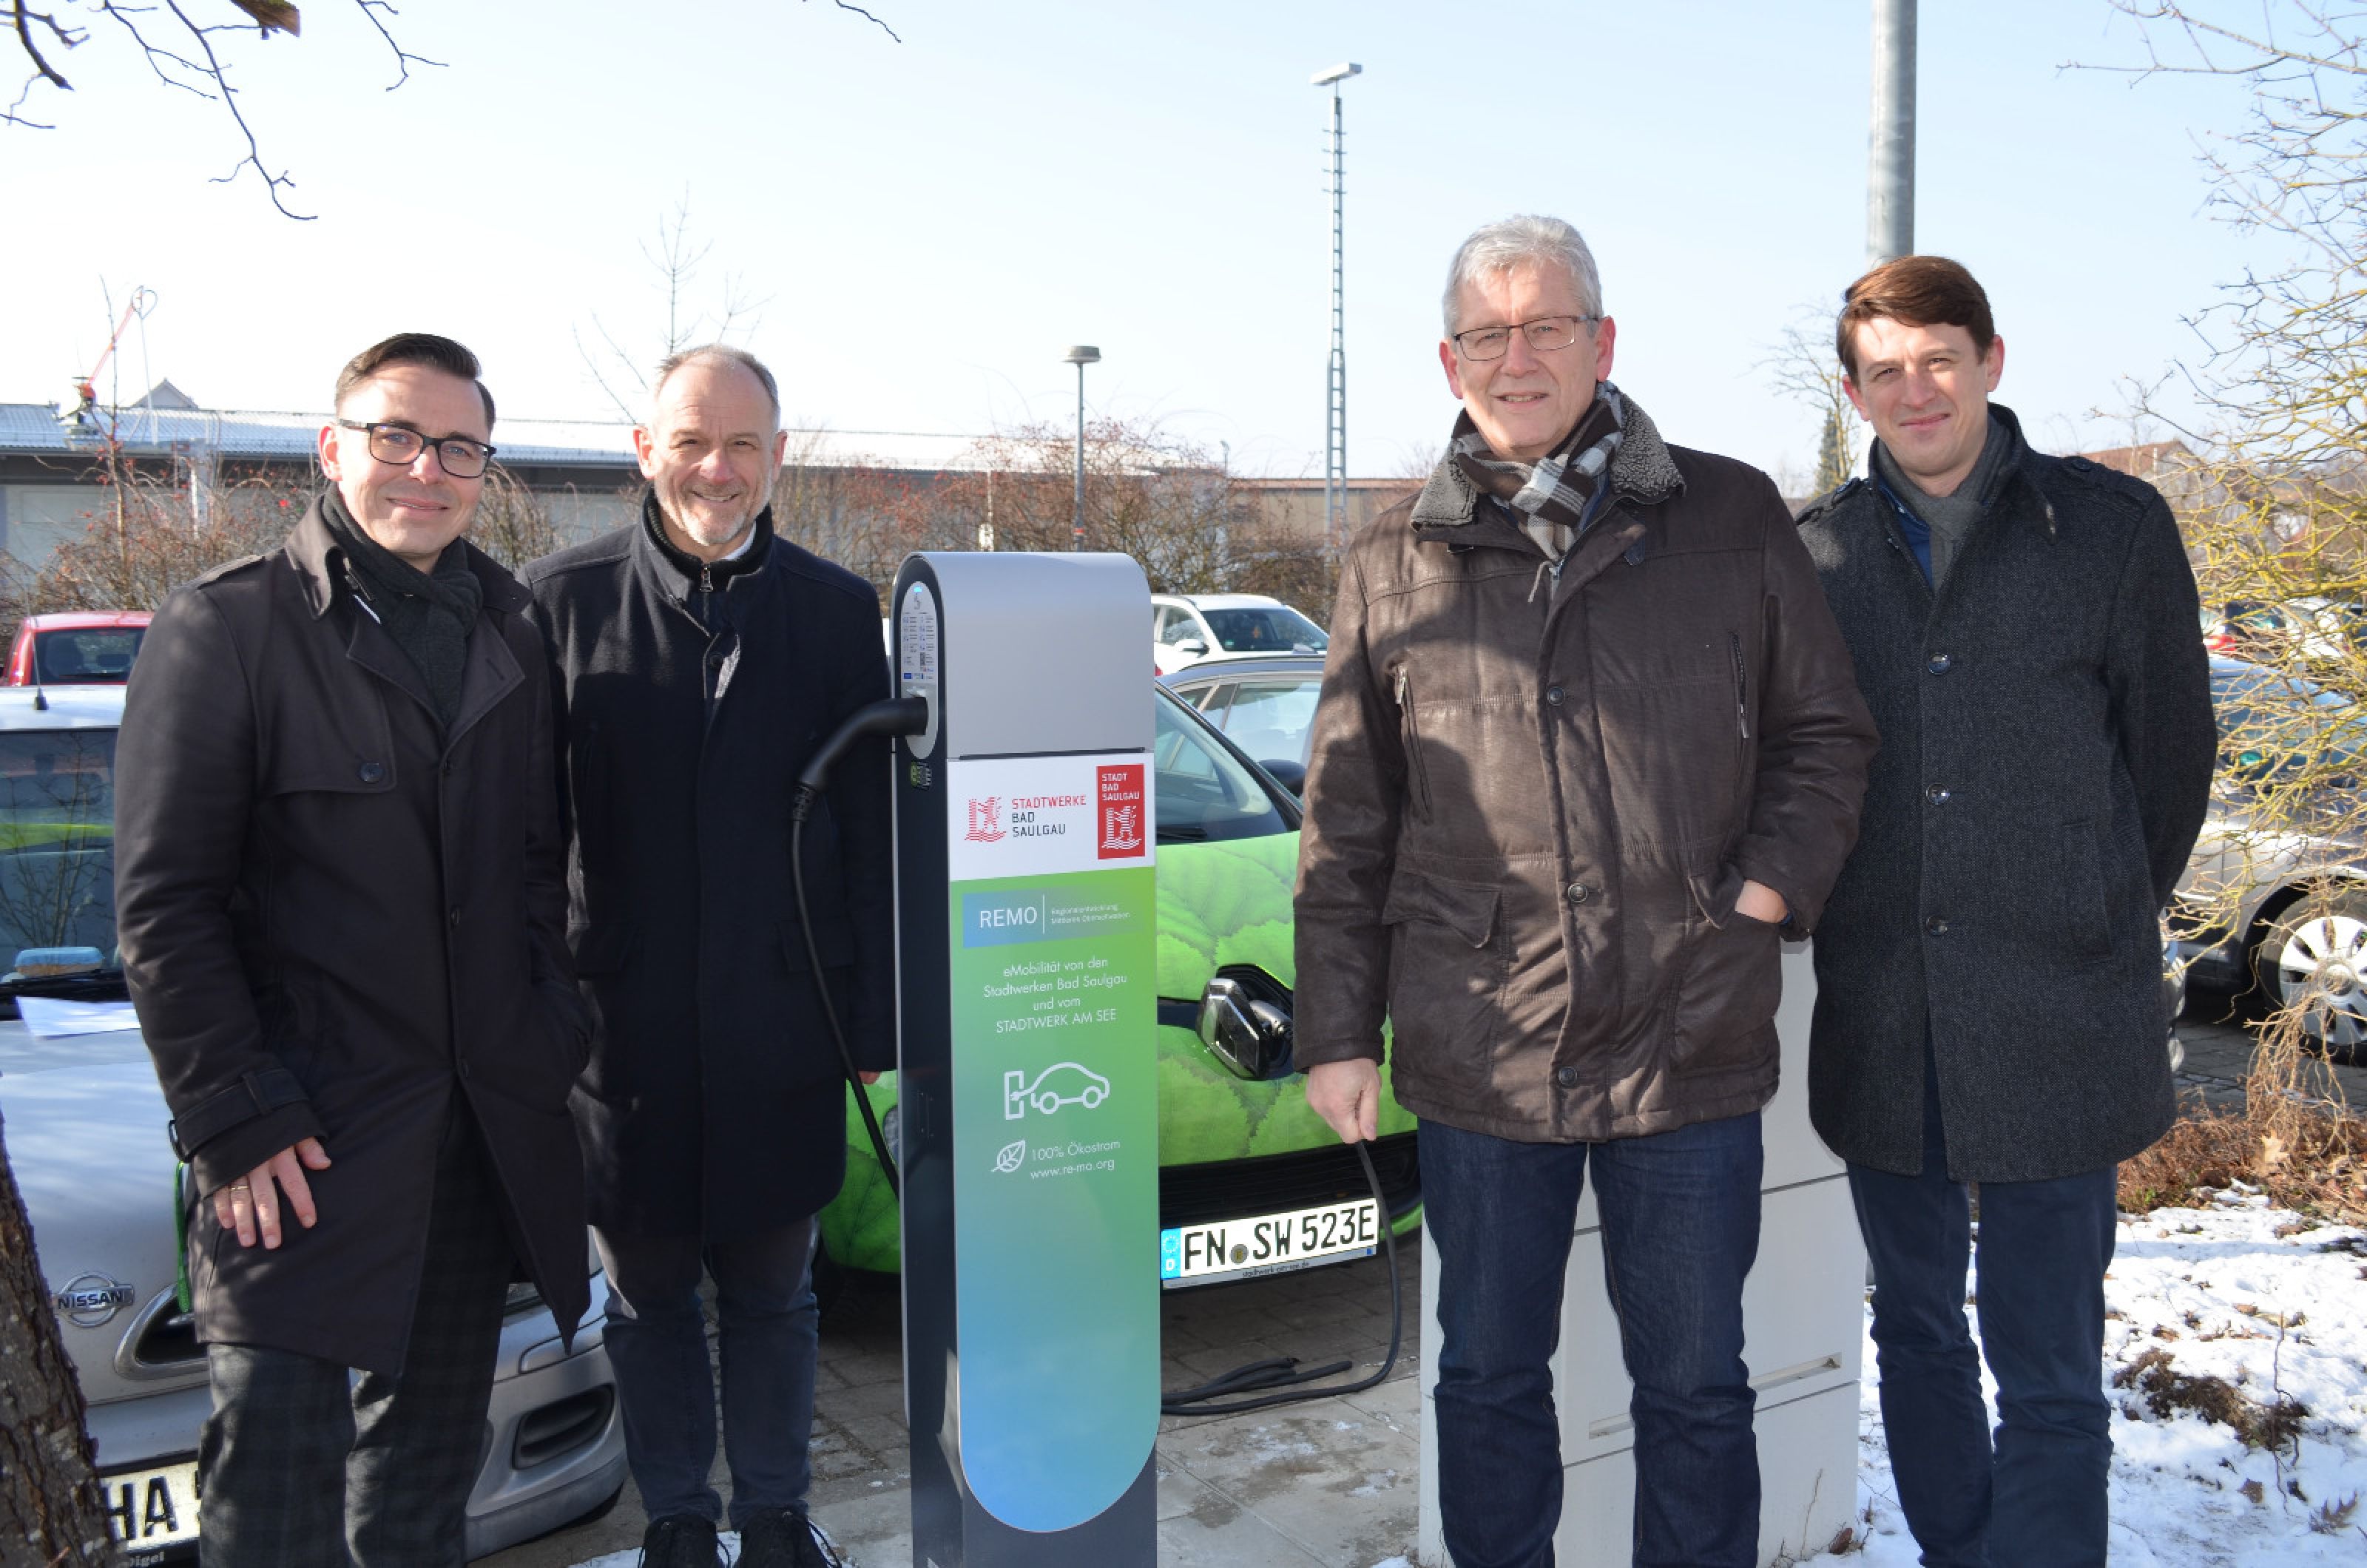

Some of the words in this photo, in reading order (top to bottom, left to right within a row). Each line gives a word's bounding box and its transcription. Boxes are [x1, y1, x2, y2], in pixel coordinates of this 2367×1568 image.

[1101, 772, 1128, 783] STADT
[1101, 783, 1119, 791] BAD
[1011, 794, 1087, 811] STADTWERKE
[1101, 791, 1141, 802] SAULGAU
[1011, 811, 1036, 824] BAD
[1012, 823, 1067, 838] SAULGAU
[979, 906, 1038, 929] REMO
[1003, 961, 1061, 977] eMobilität
[1064, 962, 1084, 972] von
[1088, 956, 1108, 969] den
[982, 979, 1053, 998] Stadtwerken
[1056, 976, 1080, 990] Bad
[1083, 973, 1128, 989] Saulgau
[1033, 996, 1054, 1011] und
[1057, 996, 1081, 1008] vom
[996, 1014, 1068, 1033] STADTWERK
[1072, 1011, 1093, 1025] AM
[1096, 1008, 1118, 1022] SEE
[1031, 1146, 1065, 1161] 100%
[1067, 1140, 1121, 1156] Ökostrom
[1030, 1159, 1115, 1180] www.re-mo.org
[1165, 1259, 1175, 1271] D
[1184, 1229, 1226, 1271] FN
[1252, 1217, 1292, 1260] SW
[1301, 1203, 1376, 1252] 523E
[58, 1290, 123, 1309] NISSAN
